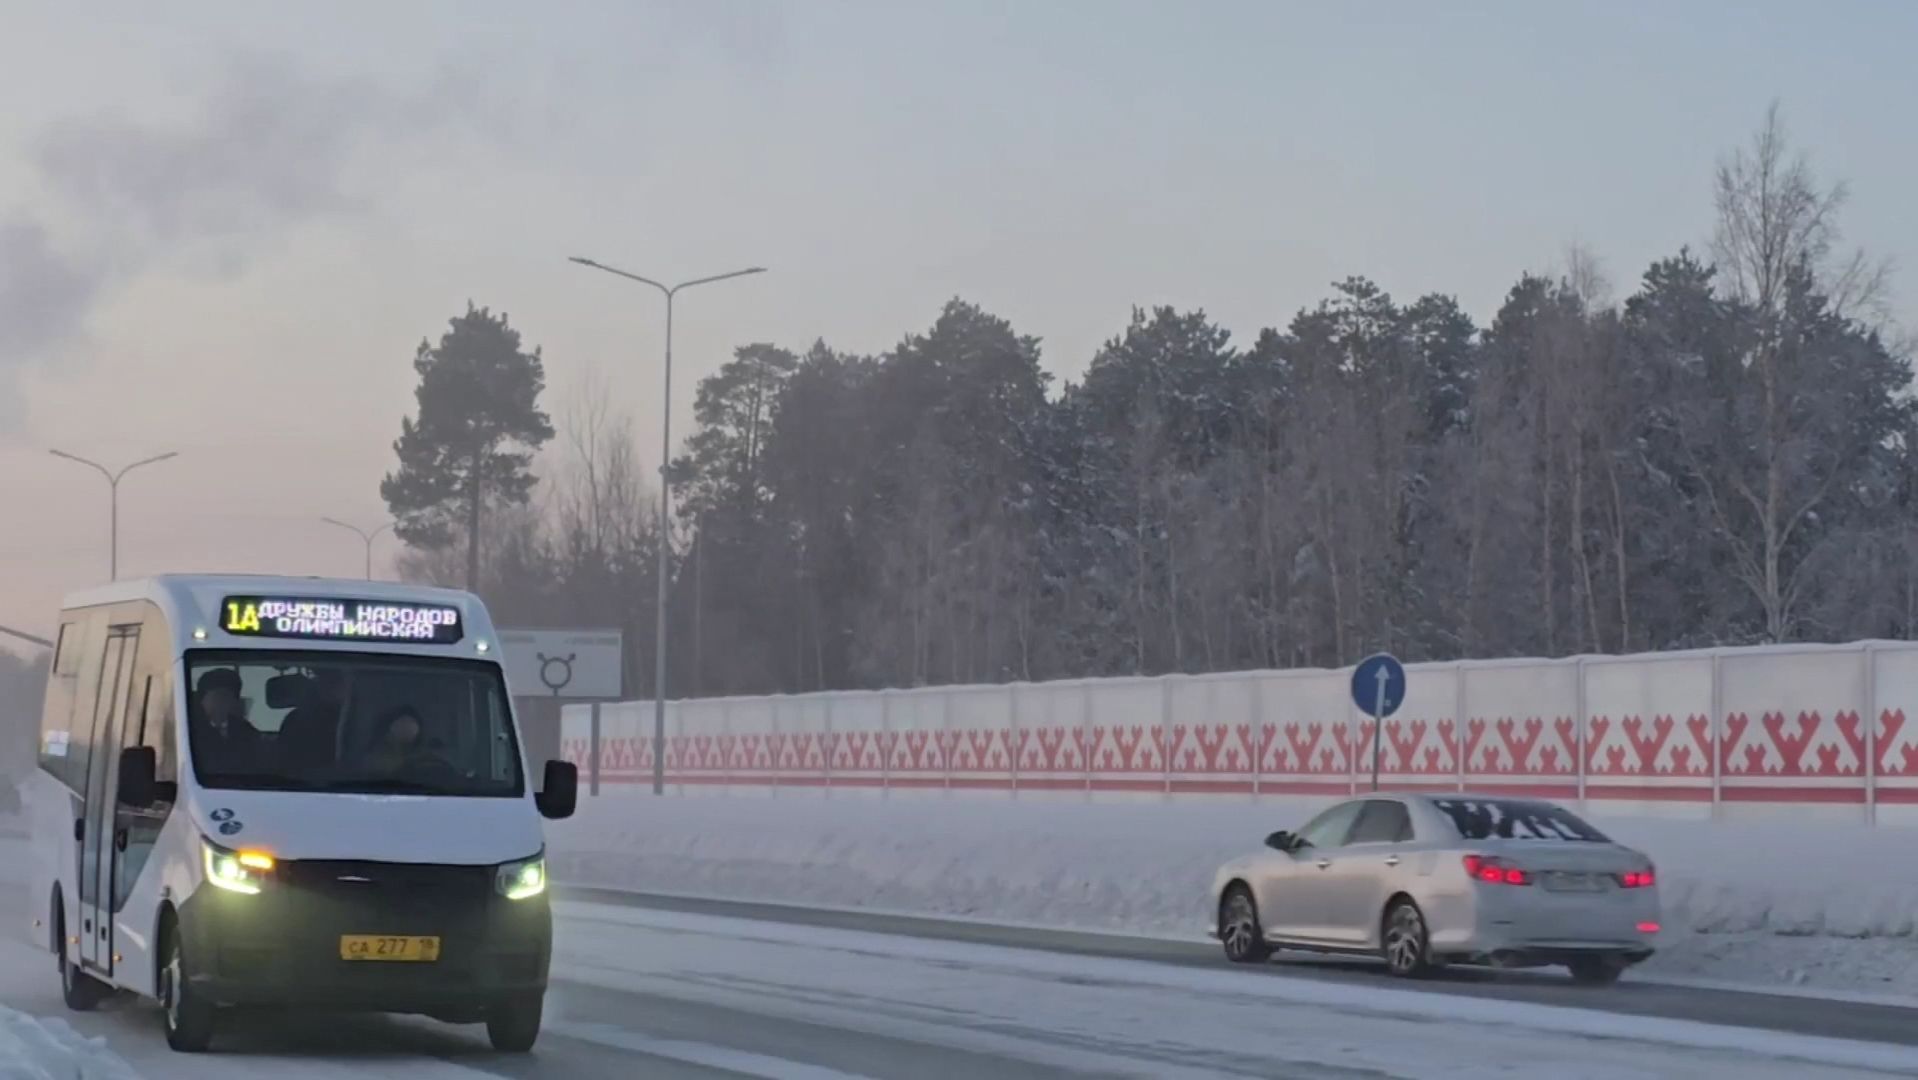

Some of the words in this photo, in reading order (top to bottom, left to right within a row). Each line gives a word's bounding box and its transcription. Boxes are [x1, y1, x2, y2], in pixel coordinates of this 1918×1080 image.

[227, 603, 260, 631] 1А
[259, 602, 345, 620] ДРУЖБЫ
[357, 605, 457, 626] НАРОДОВ
[376, 938, 408, 954] 277
